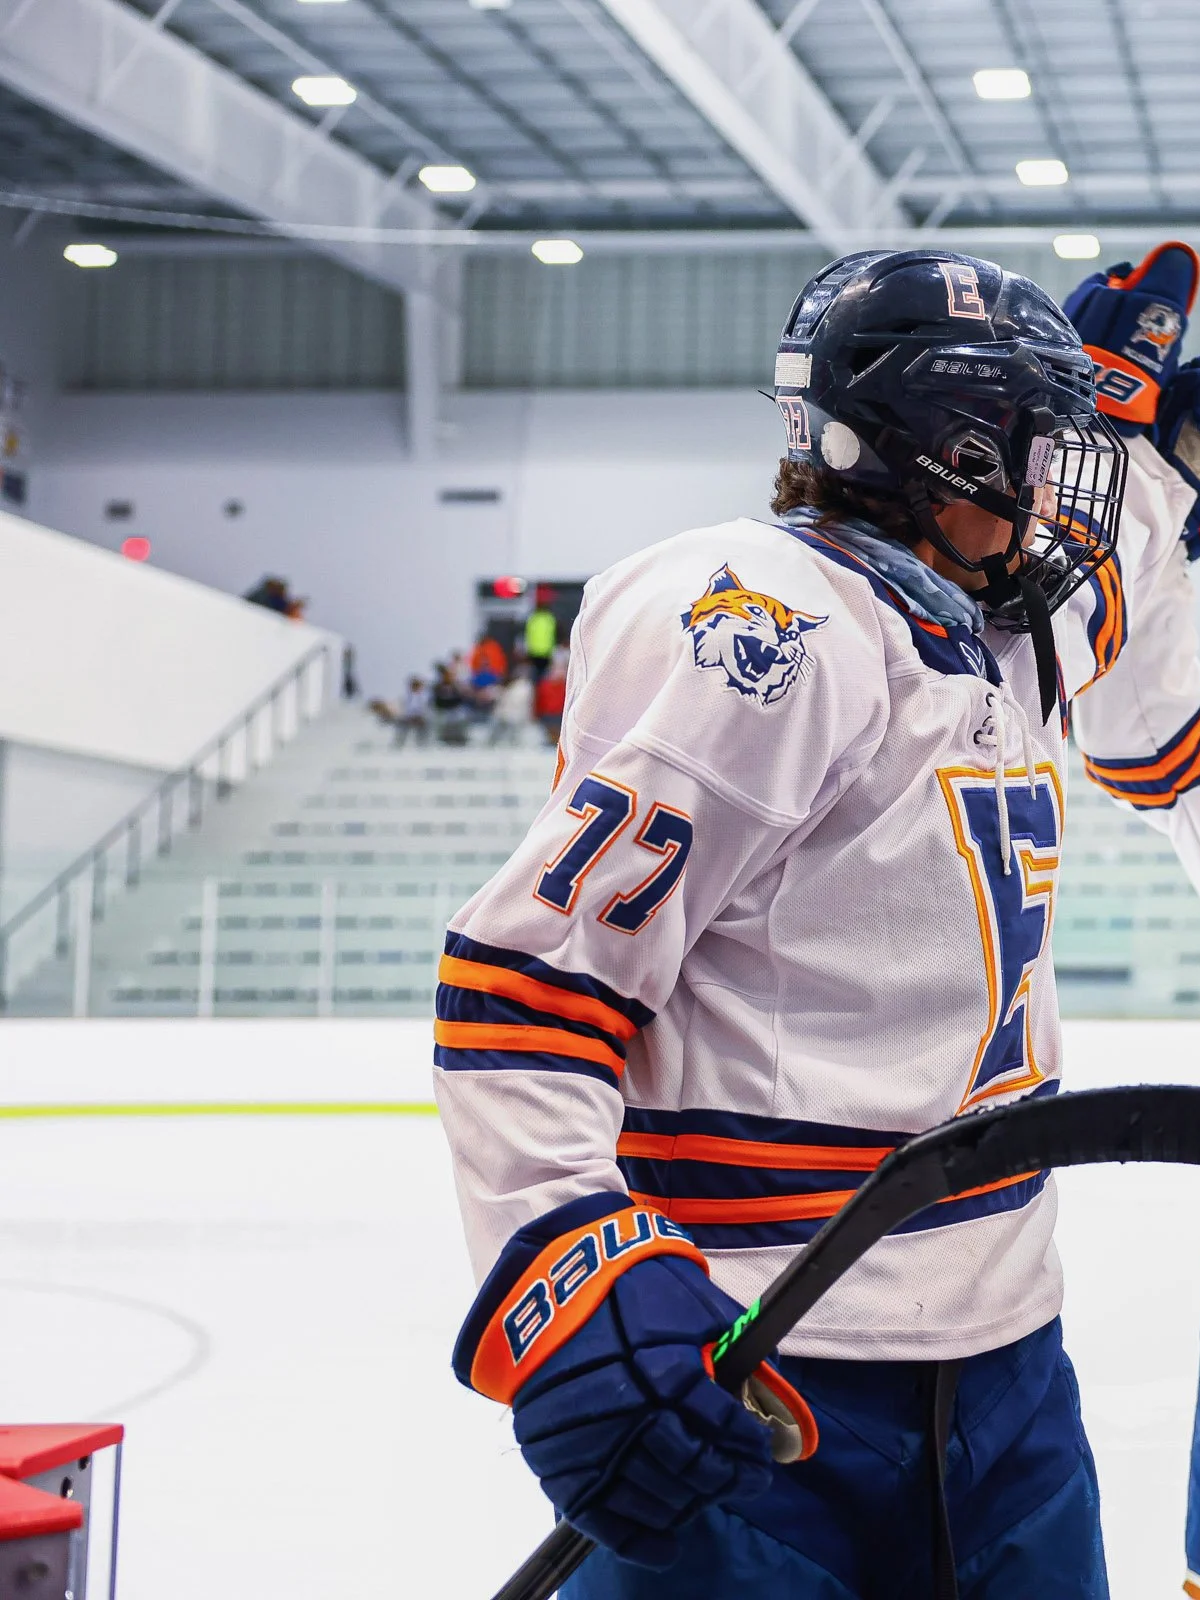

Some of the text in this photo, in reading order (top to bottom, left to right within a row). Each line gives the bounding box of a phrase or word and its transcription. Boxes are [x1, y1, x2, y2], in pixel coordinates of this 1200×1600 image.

[937, 262, 986, 320] E
[915, 454, 979, 495] BAUER
[1038, 442, 1051, 483] BAUER
[532, 770, 693, 936] 77
[935, 760, 1064, 1117] E
[502, 1211, 695, 1368] BAUE
